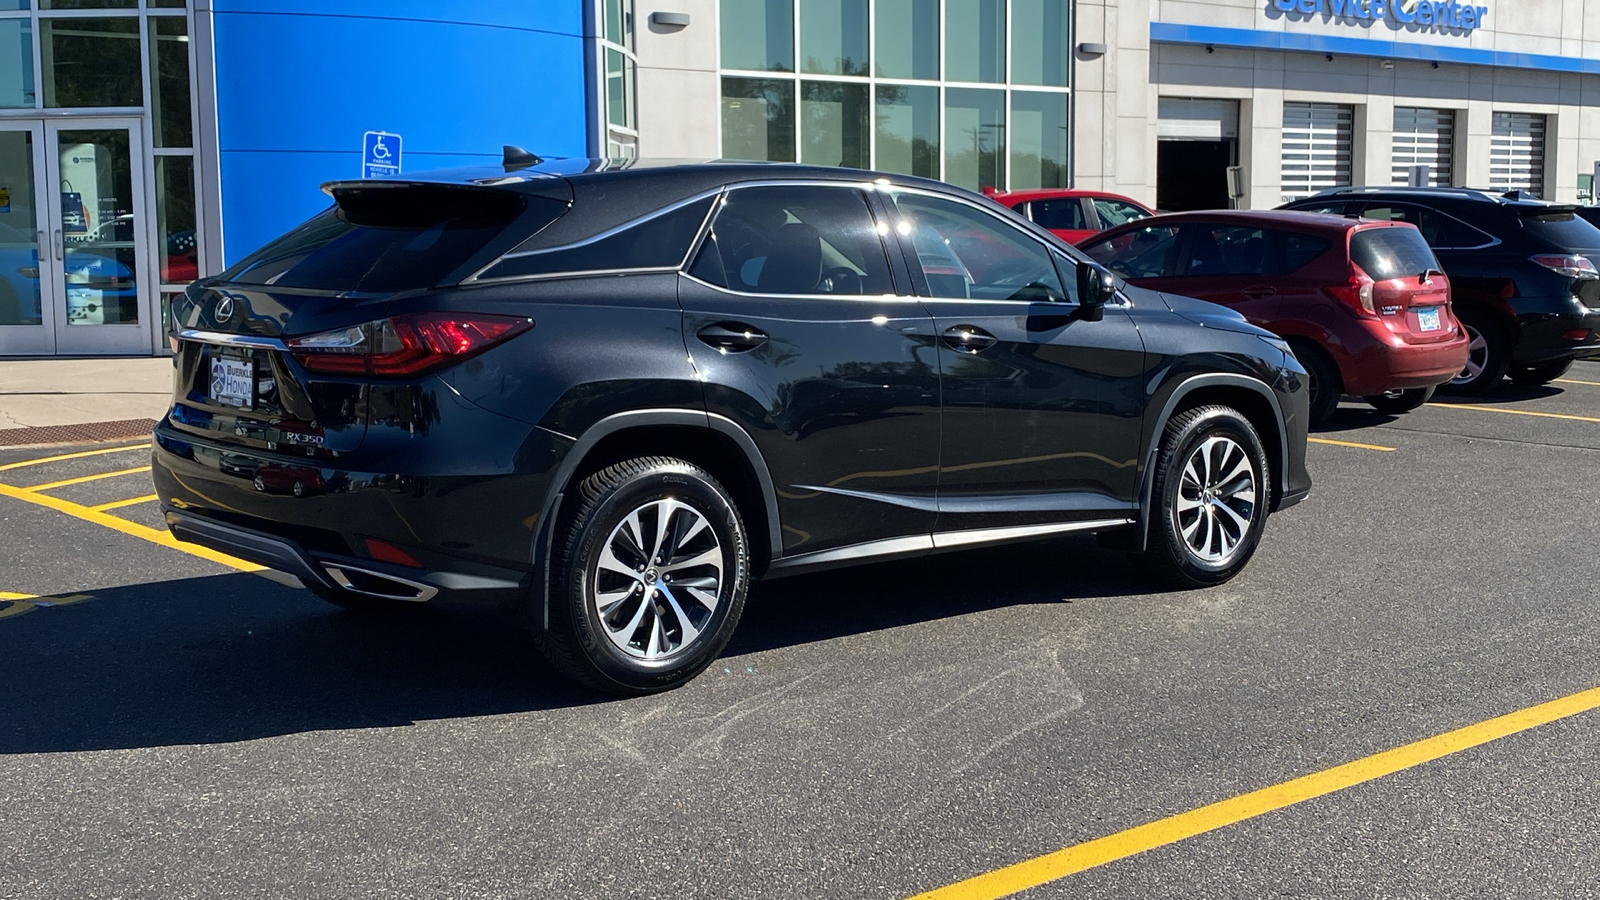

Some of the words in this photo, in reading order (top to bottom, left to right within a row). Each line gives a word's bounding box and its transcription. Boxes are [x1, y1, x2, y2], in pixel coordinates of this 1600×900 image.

[1394, 0, 1488, 29] Center
[226, 364, 253, 379] BUERKLE
[226, 376, 252, 396] HONDA
[286, 431, 301, 442] RX
[301, 434, 324, 444] 350
[734, 532, 746, 590] MICHELIN
